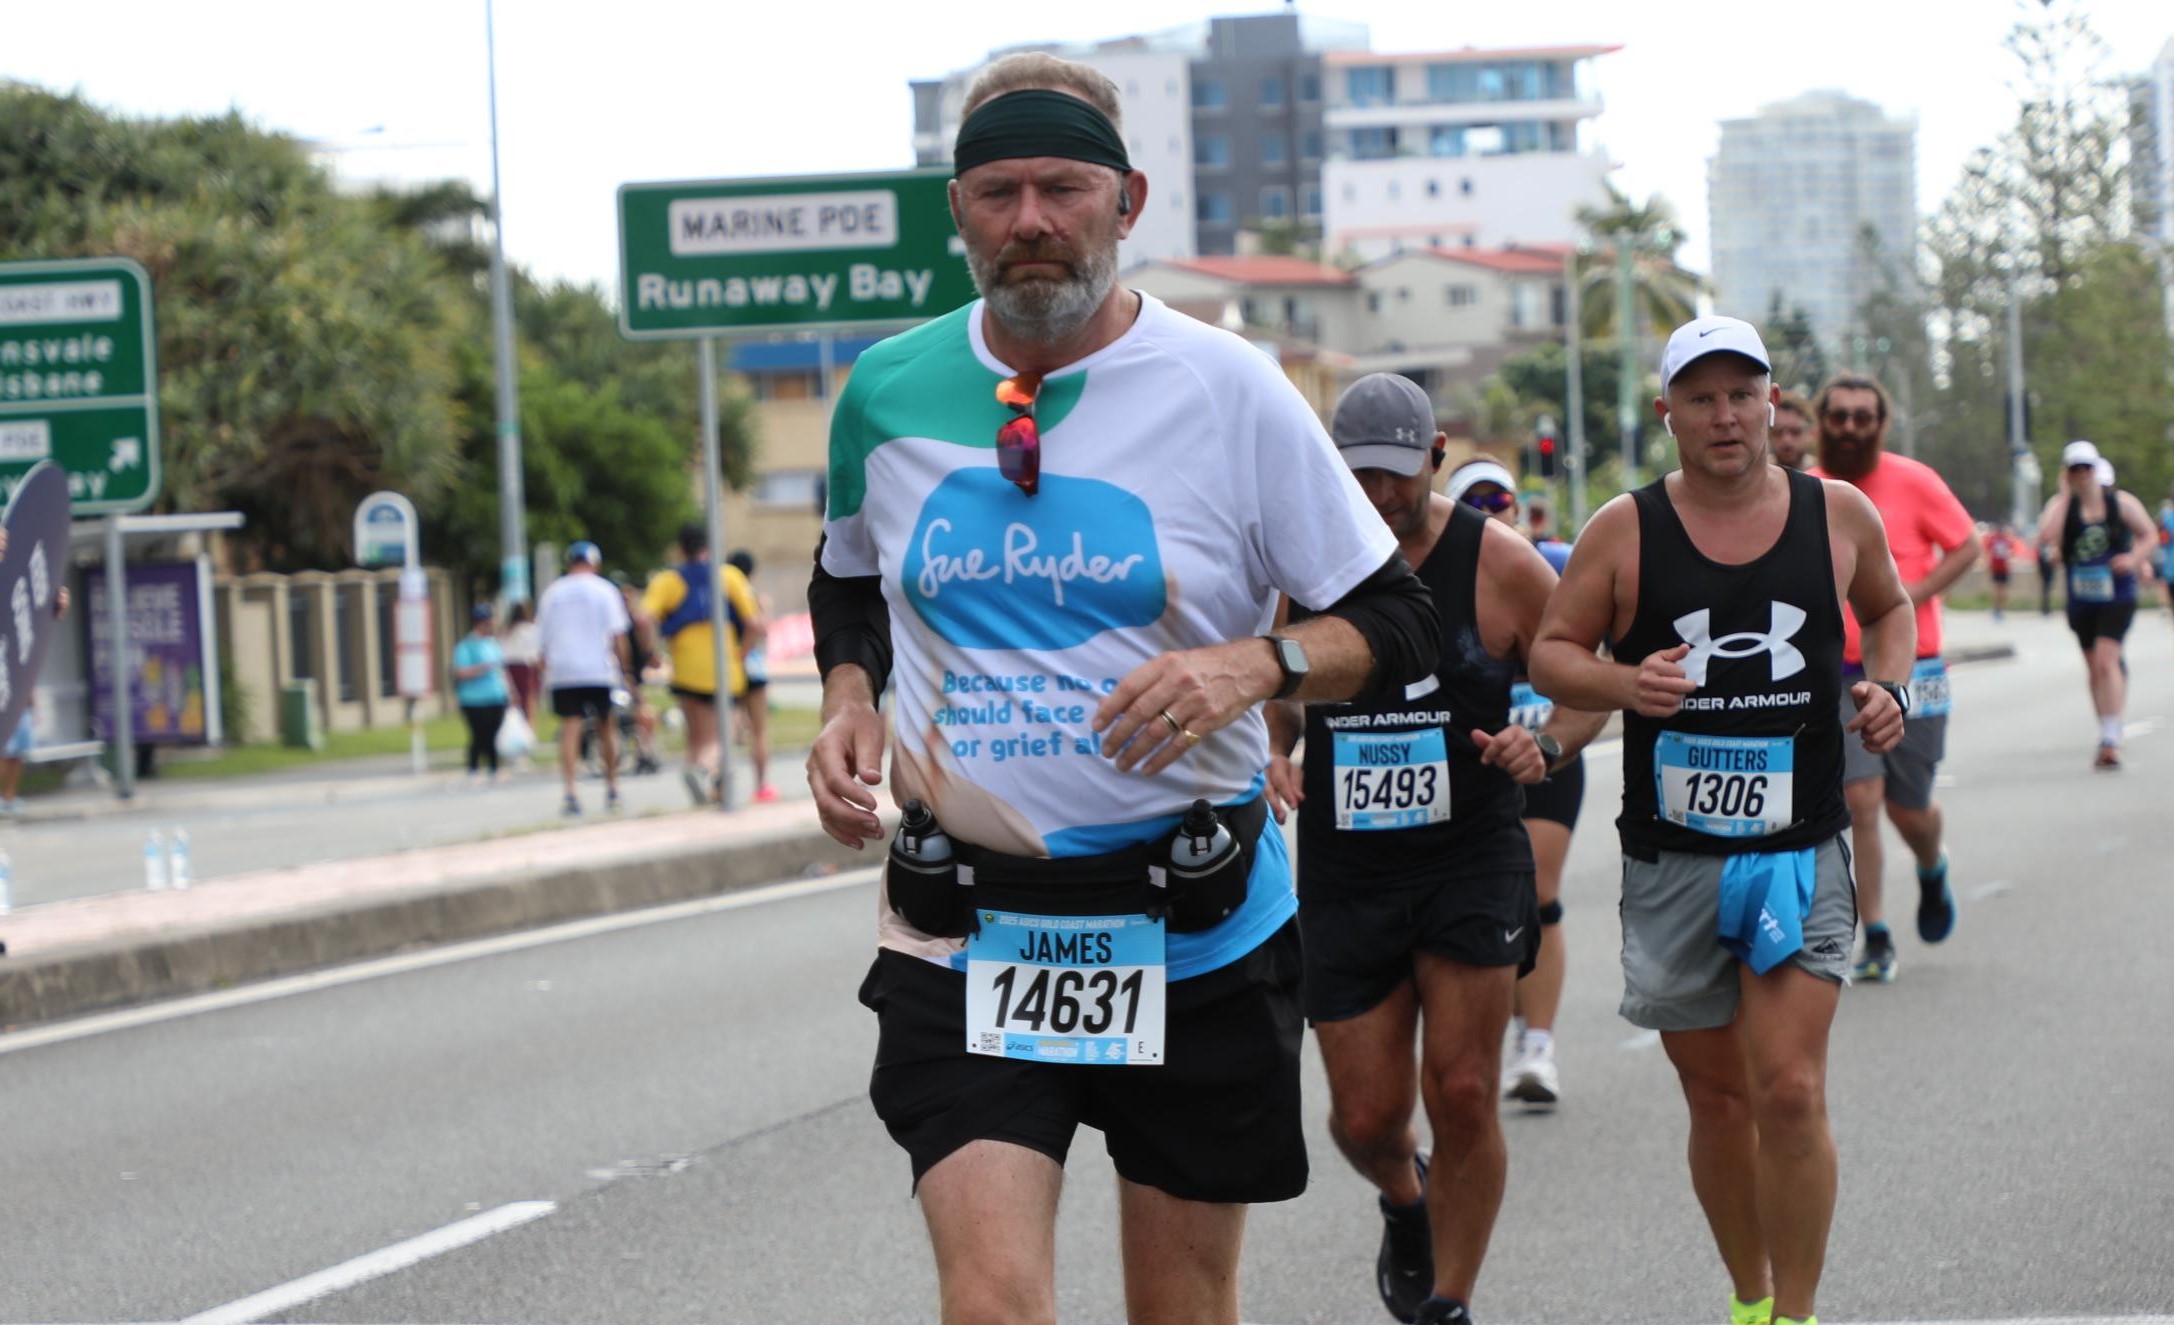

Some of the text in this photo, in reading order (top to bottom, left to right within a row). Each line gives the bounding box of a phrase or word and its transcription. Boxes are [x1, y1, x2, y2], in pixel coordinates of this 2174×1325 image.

[682, 207, 805, 240] MARINE
[637, 264, 933, 311] Runaway Bay
[918, 518, 1144, 607] Sue Ryder
[941, 670, 1046, 695] Because
[1057, 675, 1093, 691] no
[932, 698, 1085, 726] should face
[1728, 691, 1811, 709] ARMOUR
[1372, 710, 1451, 727] ARMOUR
[953, 738, 981, 758] or
[990, 731, 1062, 762] grief
[1358, 743, 1411, 764] NUSSY
[1688, 746, 1768, 771] GUTTERS
[1344, 765, 1437, 810] 15493
[1685, 773, 1768, 817] 1306
[1060, 919, 1084, 930] COAST
[1085, 918, 1126, 930] MARATHON
[1019, 930, 1112, 965] JAMES
[993, 966, 1144, 1034] 14631
[1138, 1041, 1144, 1054] E
